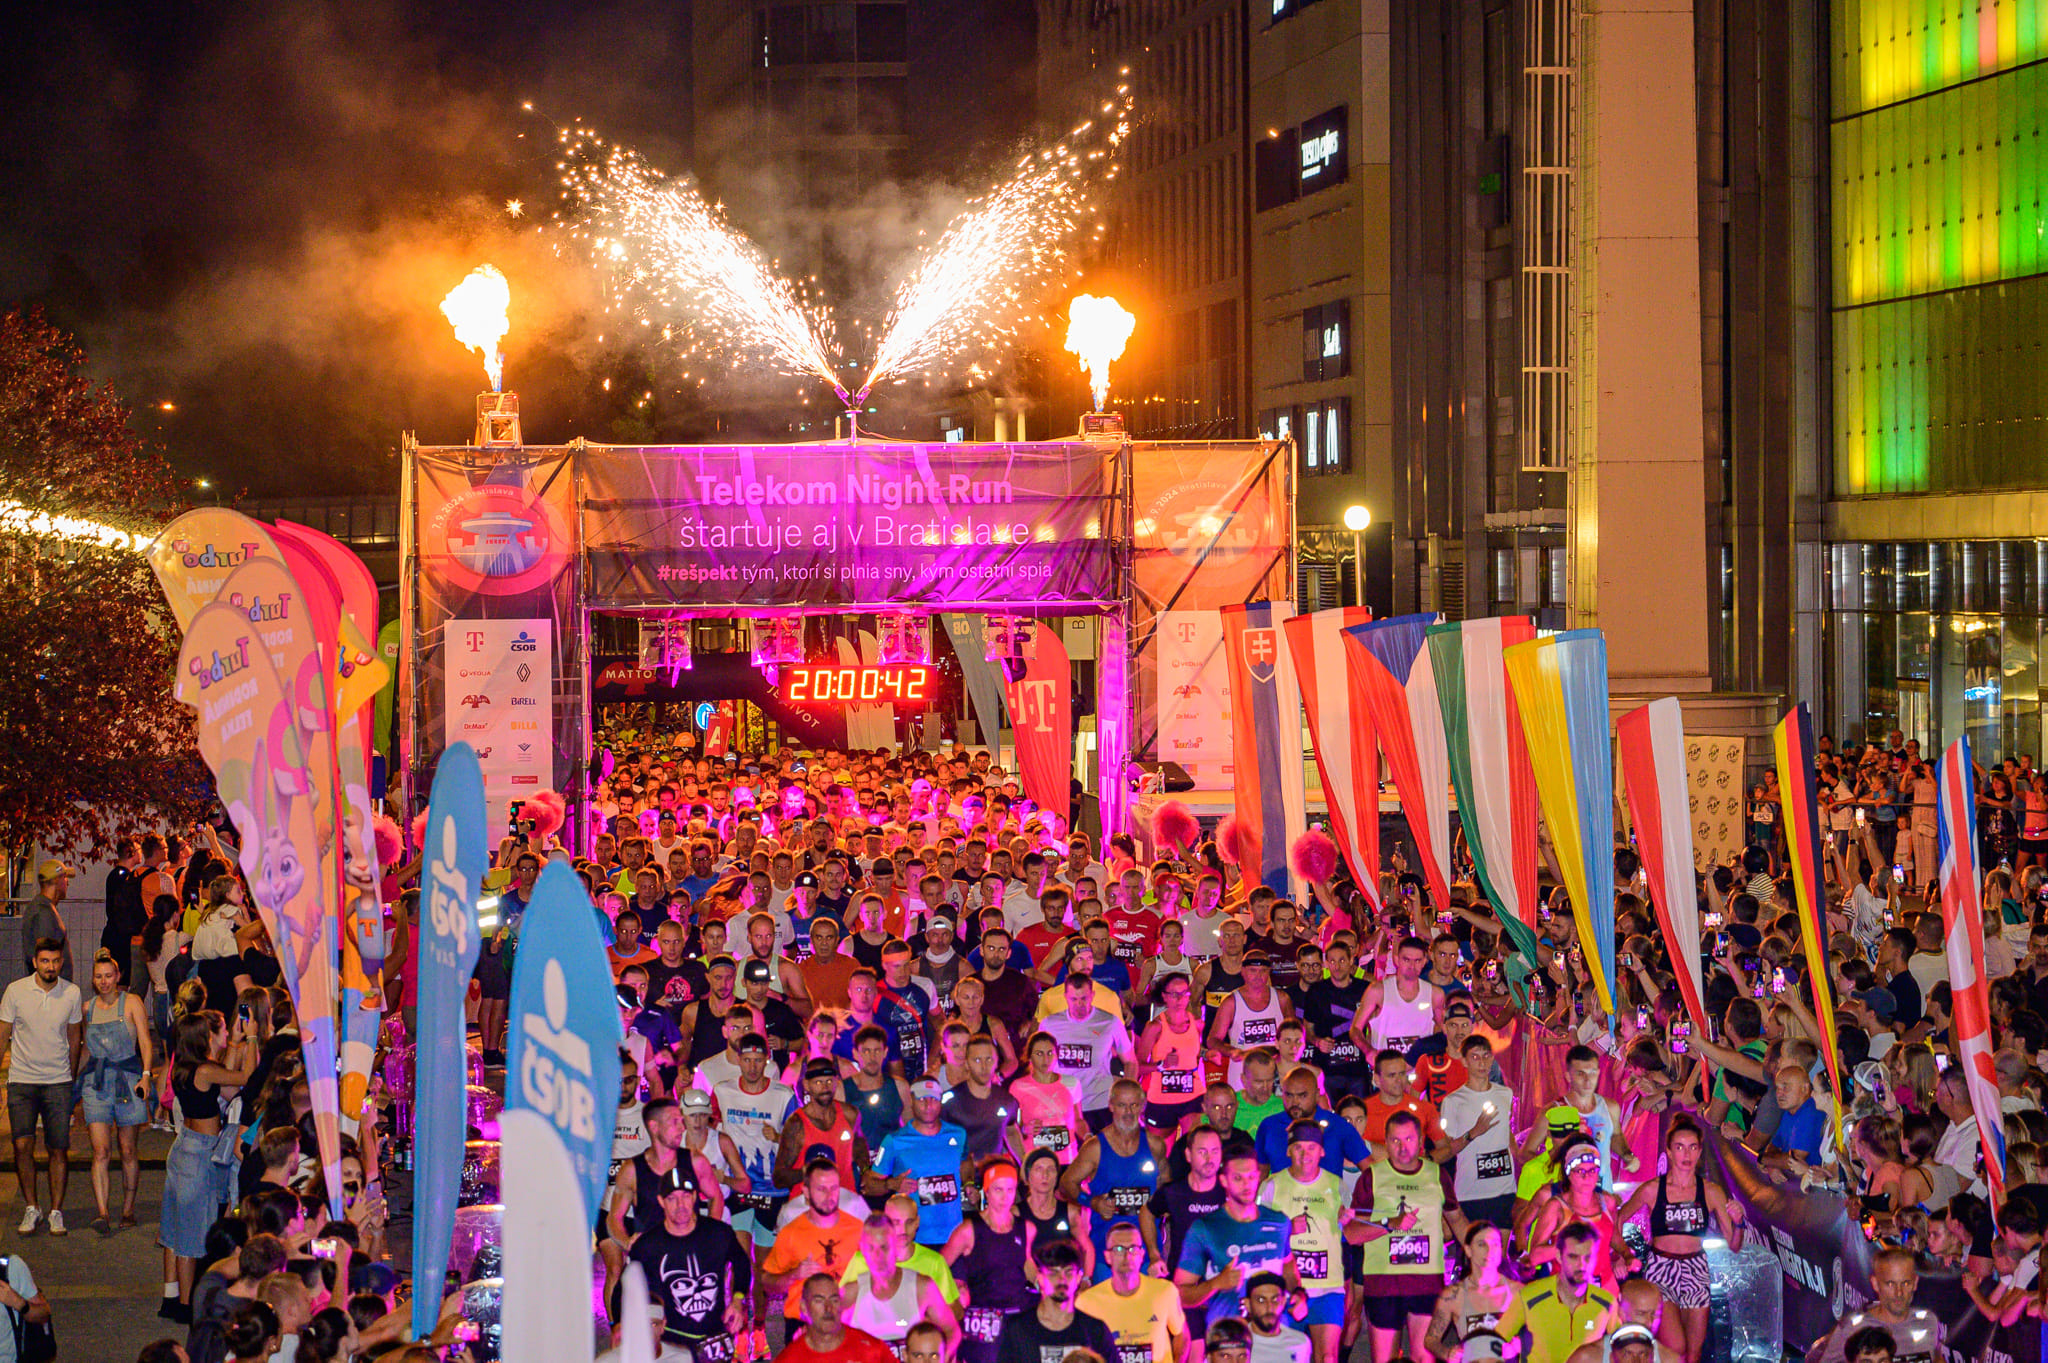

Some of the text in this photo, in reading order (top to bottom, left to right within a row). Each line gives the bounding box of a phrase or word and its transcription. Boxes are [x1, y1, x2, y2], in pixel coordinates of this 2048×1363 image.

[465, 487, 514, 498] Bratislava
[696, 474, 1012, 509] Telekom Night Run
[680, 515, 1029, 553] štartuje aj v Bratislave
[657, 562, 1052, 584] #rešpekt tým, ktorí si plnia sny, kým ostatní spia
[790, 668, 927, 700] 20:00:42
[511, 722, 537, 730] BILLA
[358, 918, 378, 938] T
[1245, 1024, 1270, 1036] 5650
[1059, 1049, 1084, 1059] 5238
[1162, 1075, 1187, 1086] 6416
[521, 1038, 596, 1142] ČSOB
[1478, 1156, 1504, 1171] 5681
[1665, 1207, 1697, 1222] 8493
[1297, 1238, 1318, 1246] BLIND
